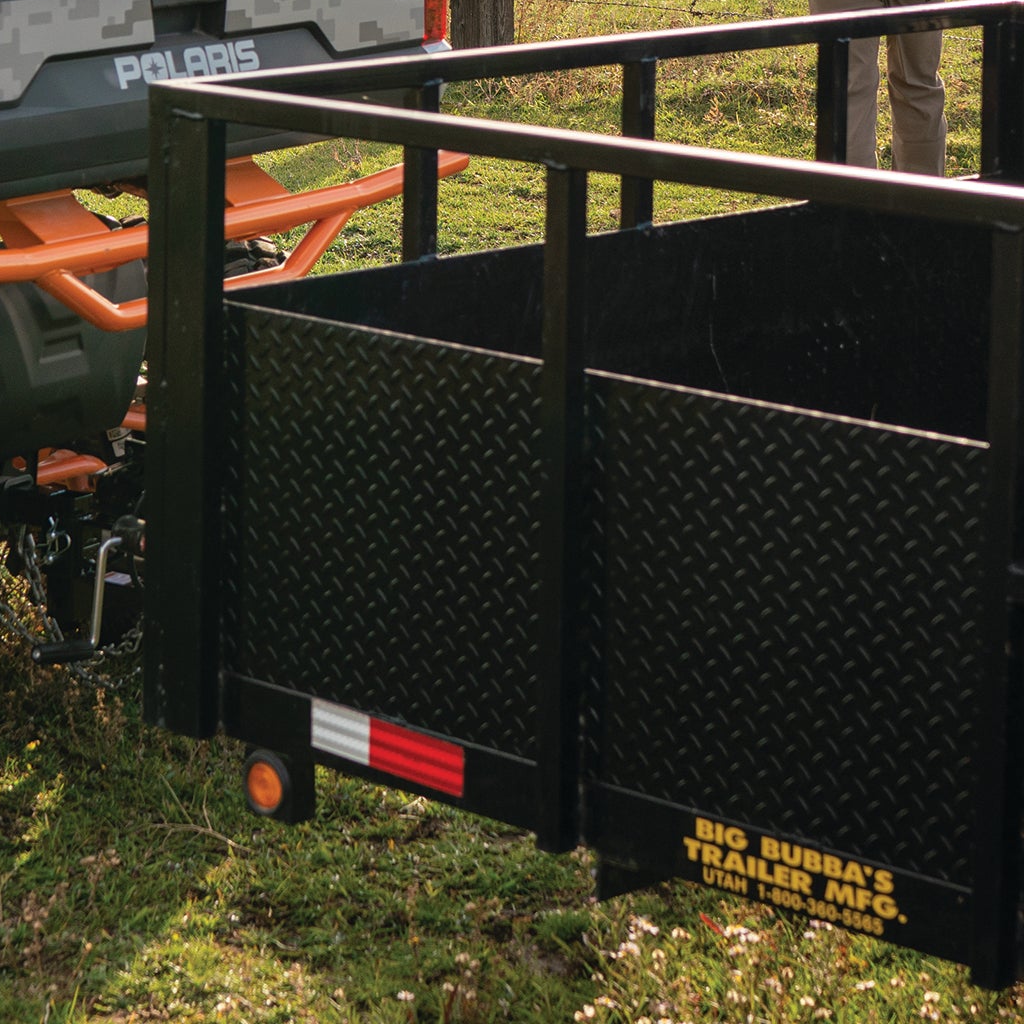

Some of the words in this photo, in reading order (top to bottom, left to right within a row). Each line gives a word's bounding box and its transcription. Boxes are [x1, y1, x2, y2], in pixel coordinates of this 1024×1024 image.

[113, 39, 260, 90] POLARIS
[683, 836, 813, 895] TRAILER
[824, 878, 908, 925] MFG.
[695, 816, 749, 851] BIG
[760, 835, 894, 894] BUBBA'S
[702, 866, 748, 895] UTAH
